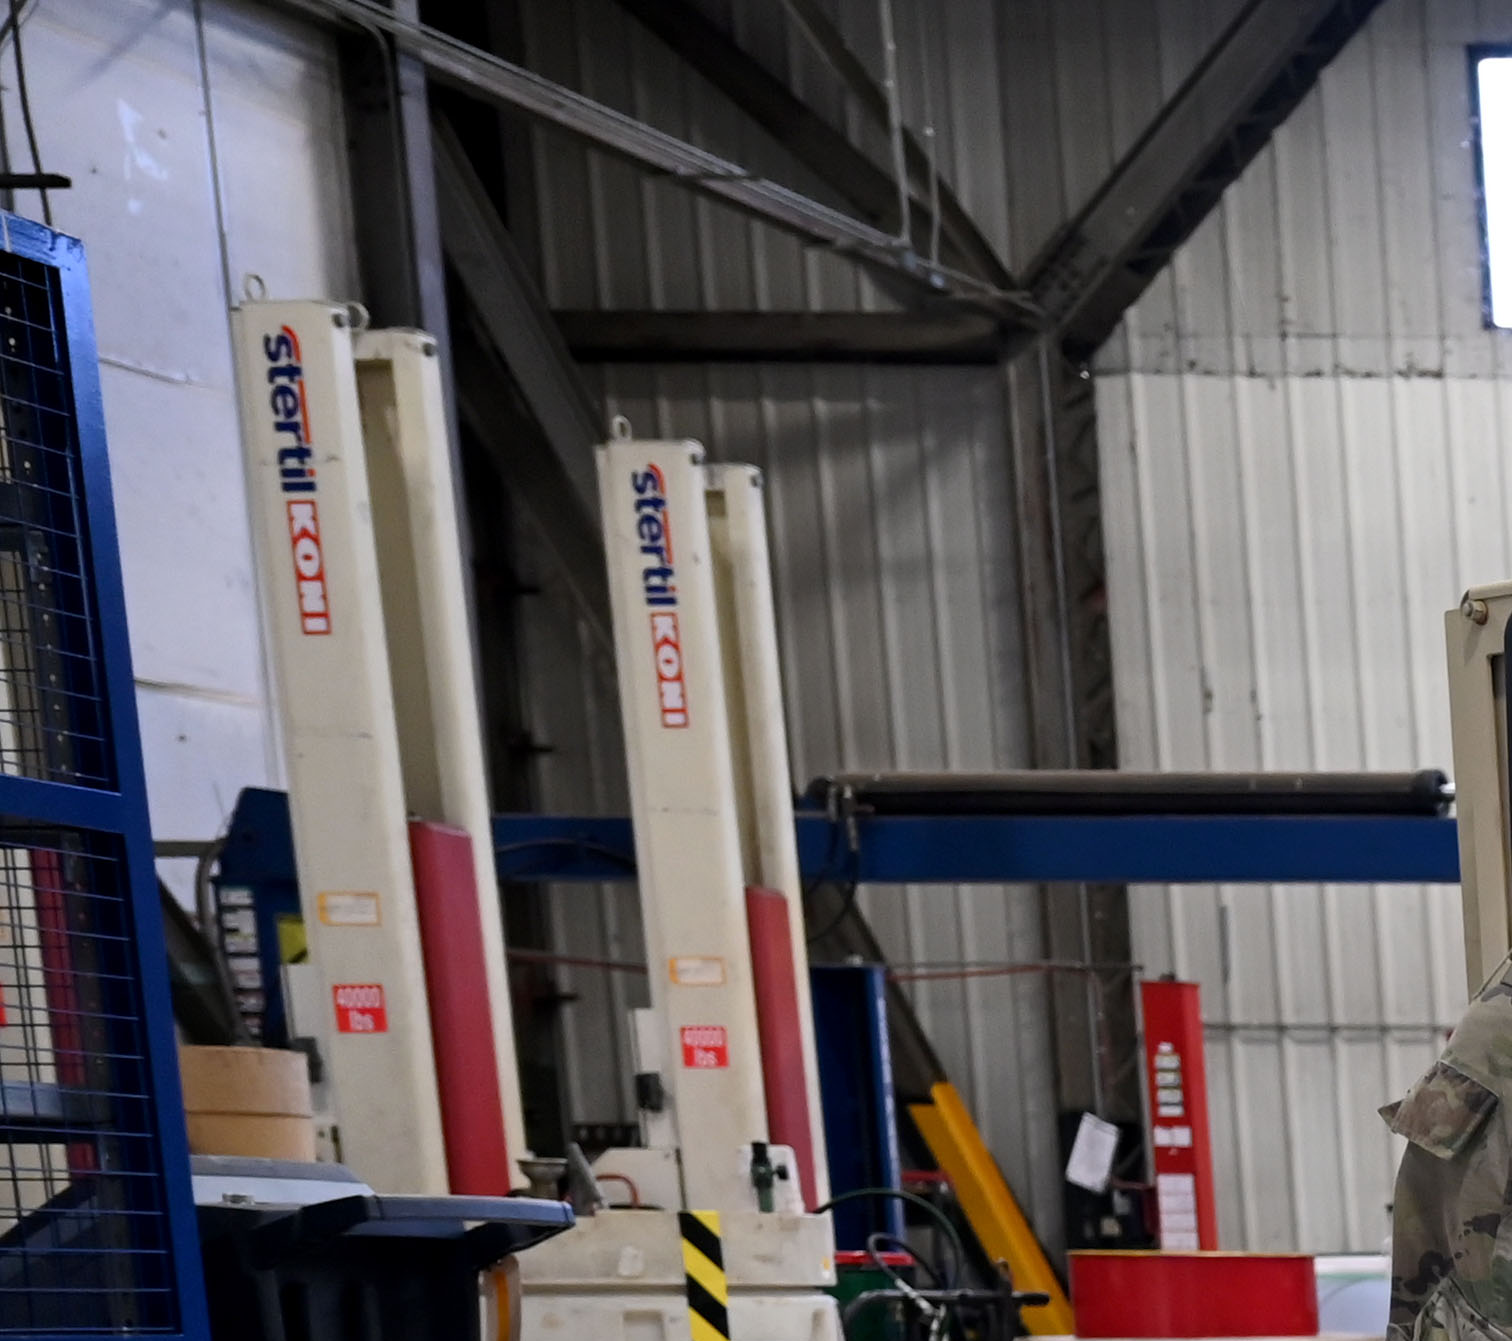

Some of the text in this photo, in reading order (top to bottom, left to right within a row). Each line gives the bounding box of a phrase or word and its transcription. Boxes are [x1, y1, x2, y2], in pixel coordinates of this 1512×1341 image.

[264, 327, 329, 632] stertil KONI
[632, 466, 688, 727] stertil KONI
